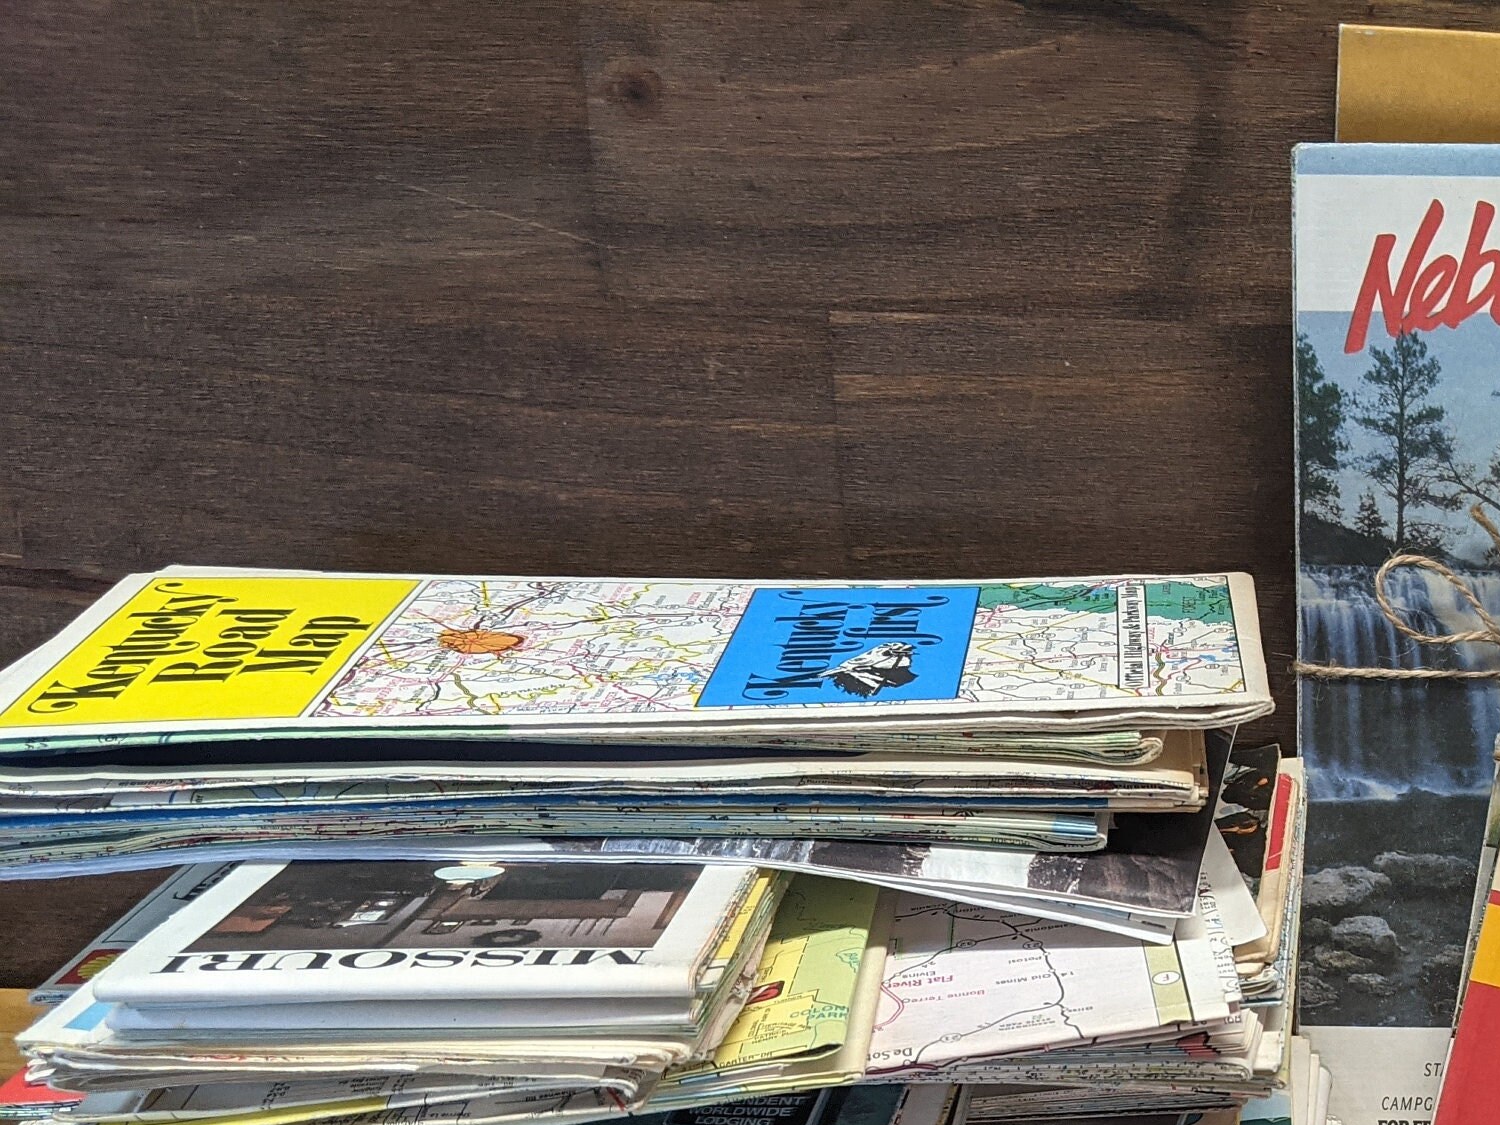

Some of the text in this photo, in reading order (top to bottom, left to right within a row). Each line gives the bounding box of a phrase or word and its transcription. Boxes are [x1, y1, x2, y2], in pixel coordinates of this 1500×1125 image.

[1121, 586, 1141, 599] Map
[1121, 600, 1142, 623] Parkway
[27, 582, 239, 714] Kentucky
[147, 607, 297, 685] Road
[237, 615, 374, 676] Map
[742, 590, 868, 700] Kentucky
[1123, 630, 1144, 660] Highway
[1125, 661, 1144, 688] Official
[151, 948, 653, 975] MISSOURI
[887, 974, 954, 989] Flat River
[995, 973, 1052, 985] Old Mines
[688, 1106, 796, 1117] WORLDWIDE
[1381, 1096, 1433, 1112] CAMPG
